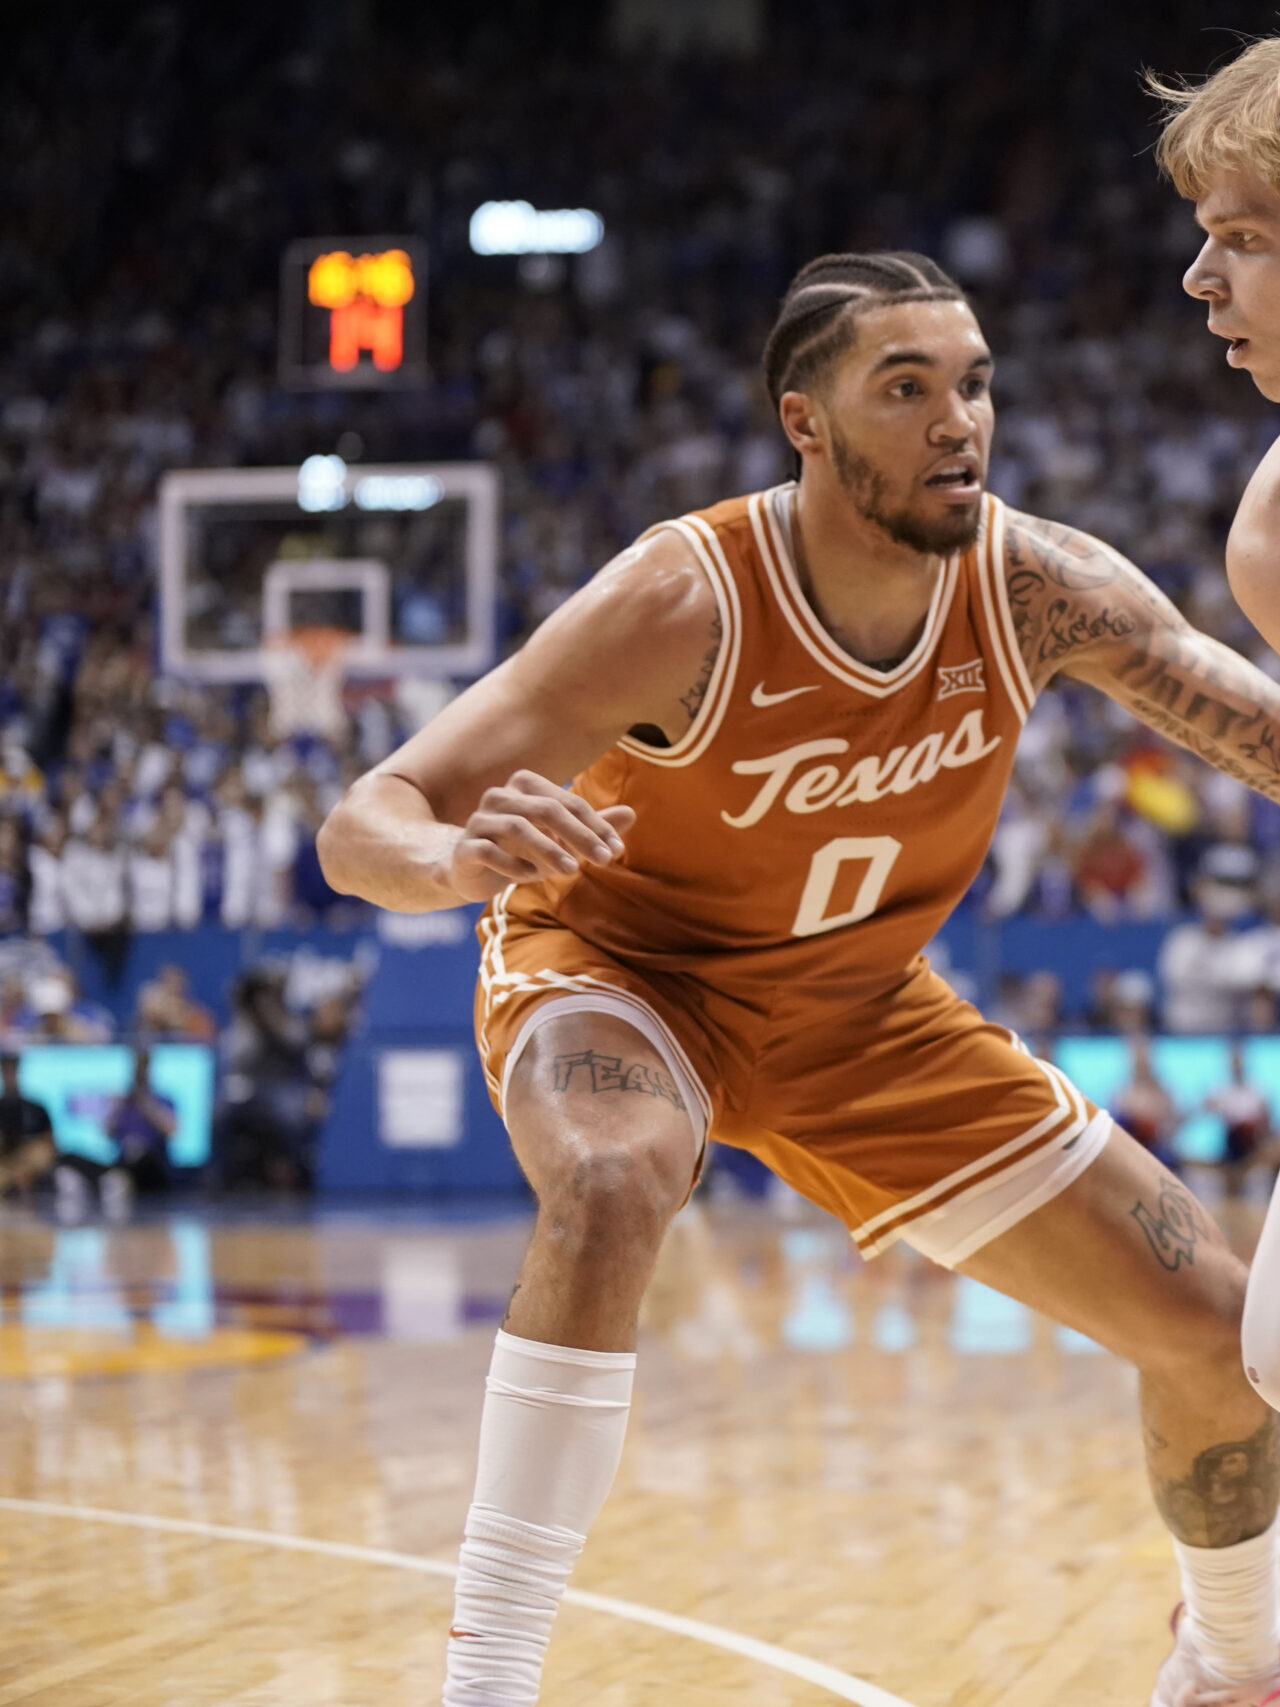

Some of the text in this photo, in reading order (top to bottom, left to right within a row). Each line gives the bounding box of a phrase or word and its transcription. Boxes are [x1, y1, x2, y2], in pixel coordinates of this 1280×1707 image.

[937, 658, 986, 701] XII
[720, 709, 1002, 829] Texas
[792, 835, 902, 937] 0
